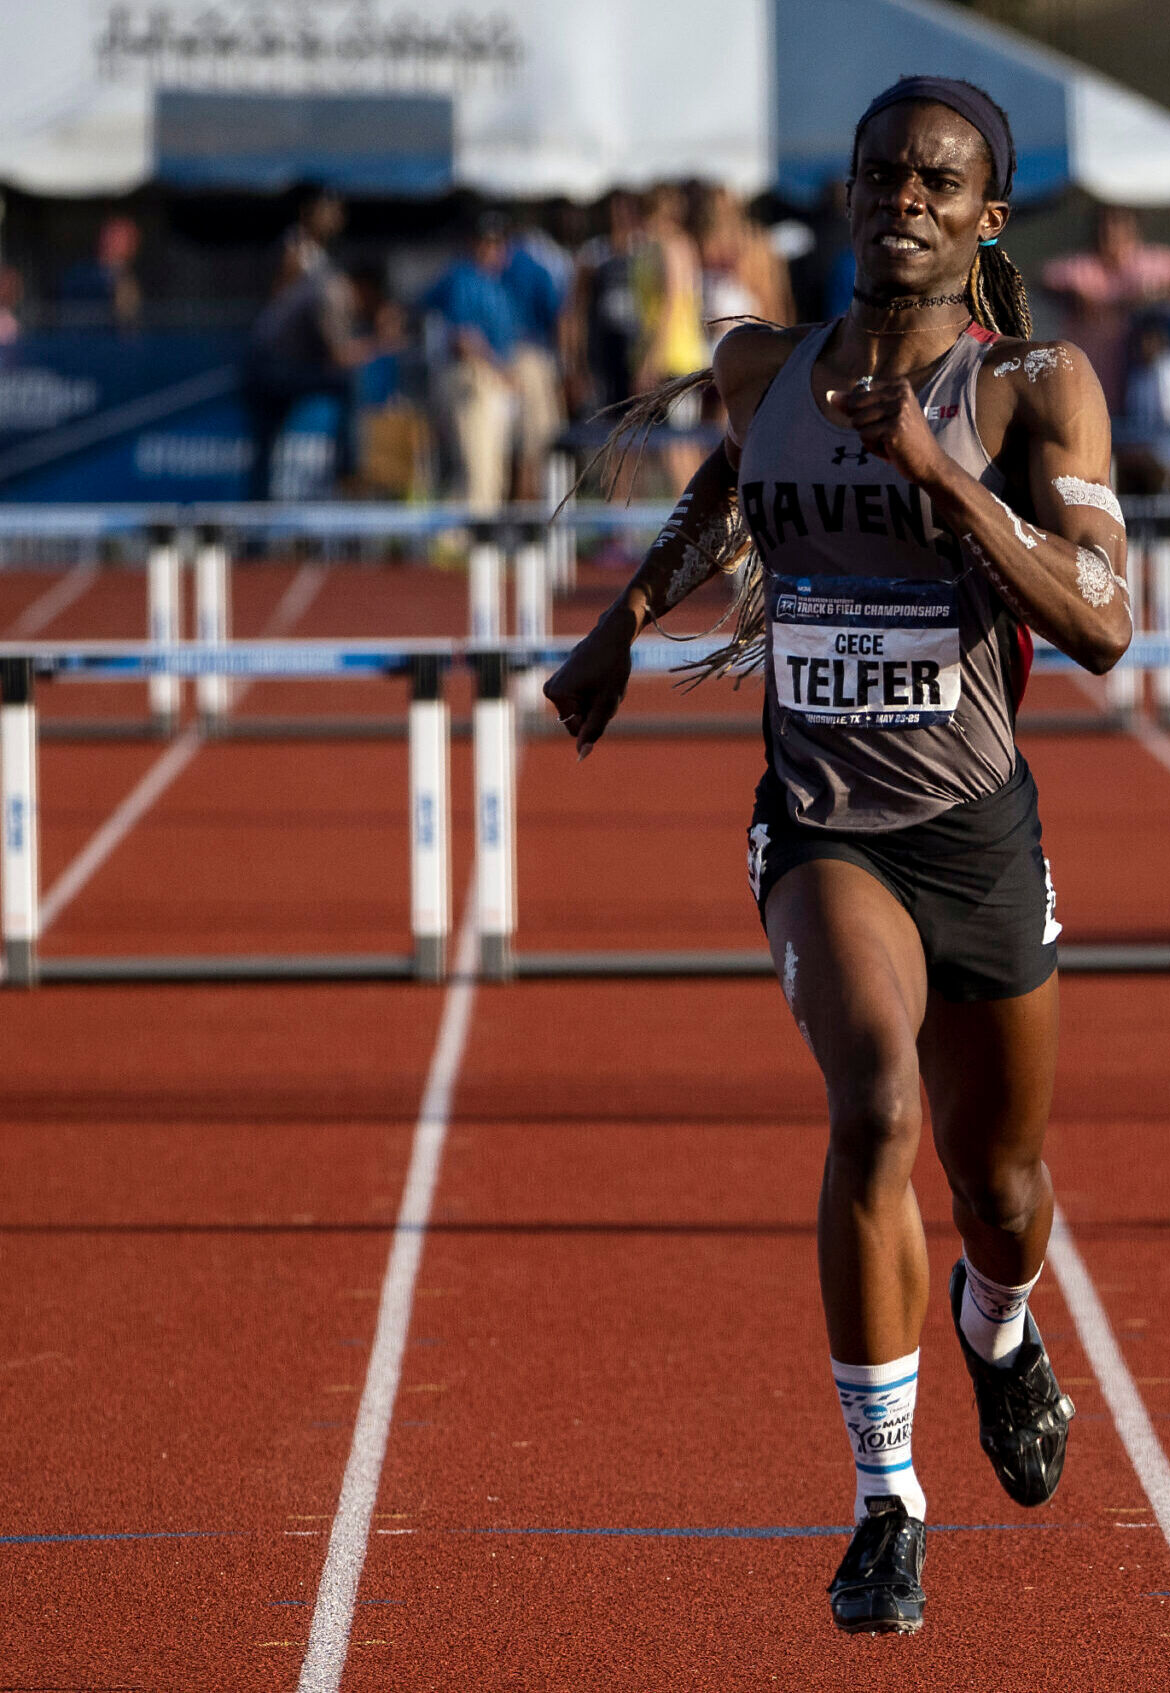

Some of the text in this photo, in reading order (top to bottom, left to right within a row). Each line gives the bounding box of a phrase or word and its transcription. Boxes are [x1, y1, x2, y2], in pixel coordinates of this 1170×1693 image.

[924, 405, 960, 420] E10
[797, 602, 826, 615] TRACK
[836, 604, 861, 616] FIELD
[864, 604, 950, 618] CHAMPIONSHIPS
[835, 633, 884, 656] CECE
[786, 656, 941, 707] TELFER
[850, 714, 861, 724] TX
[876, 713, 895, 724] MAY
[848, 1422, 912, 1454] YOUR
